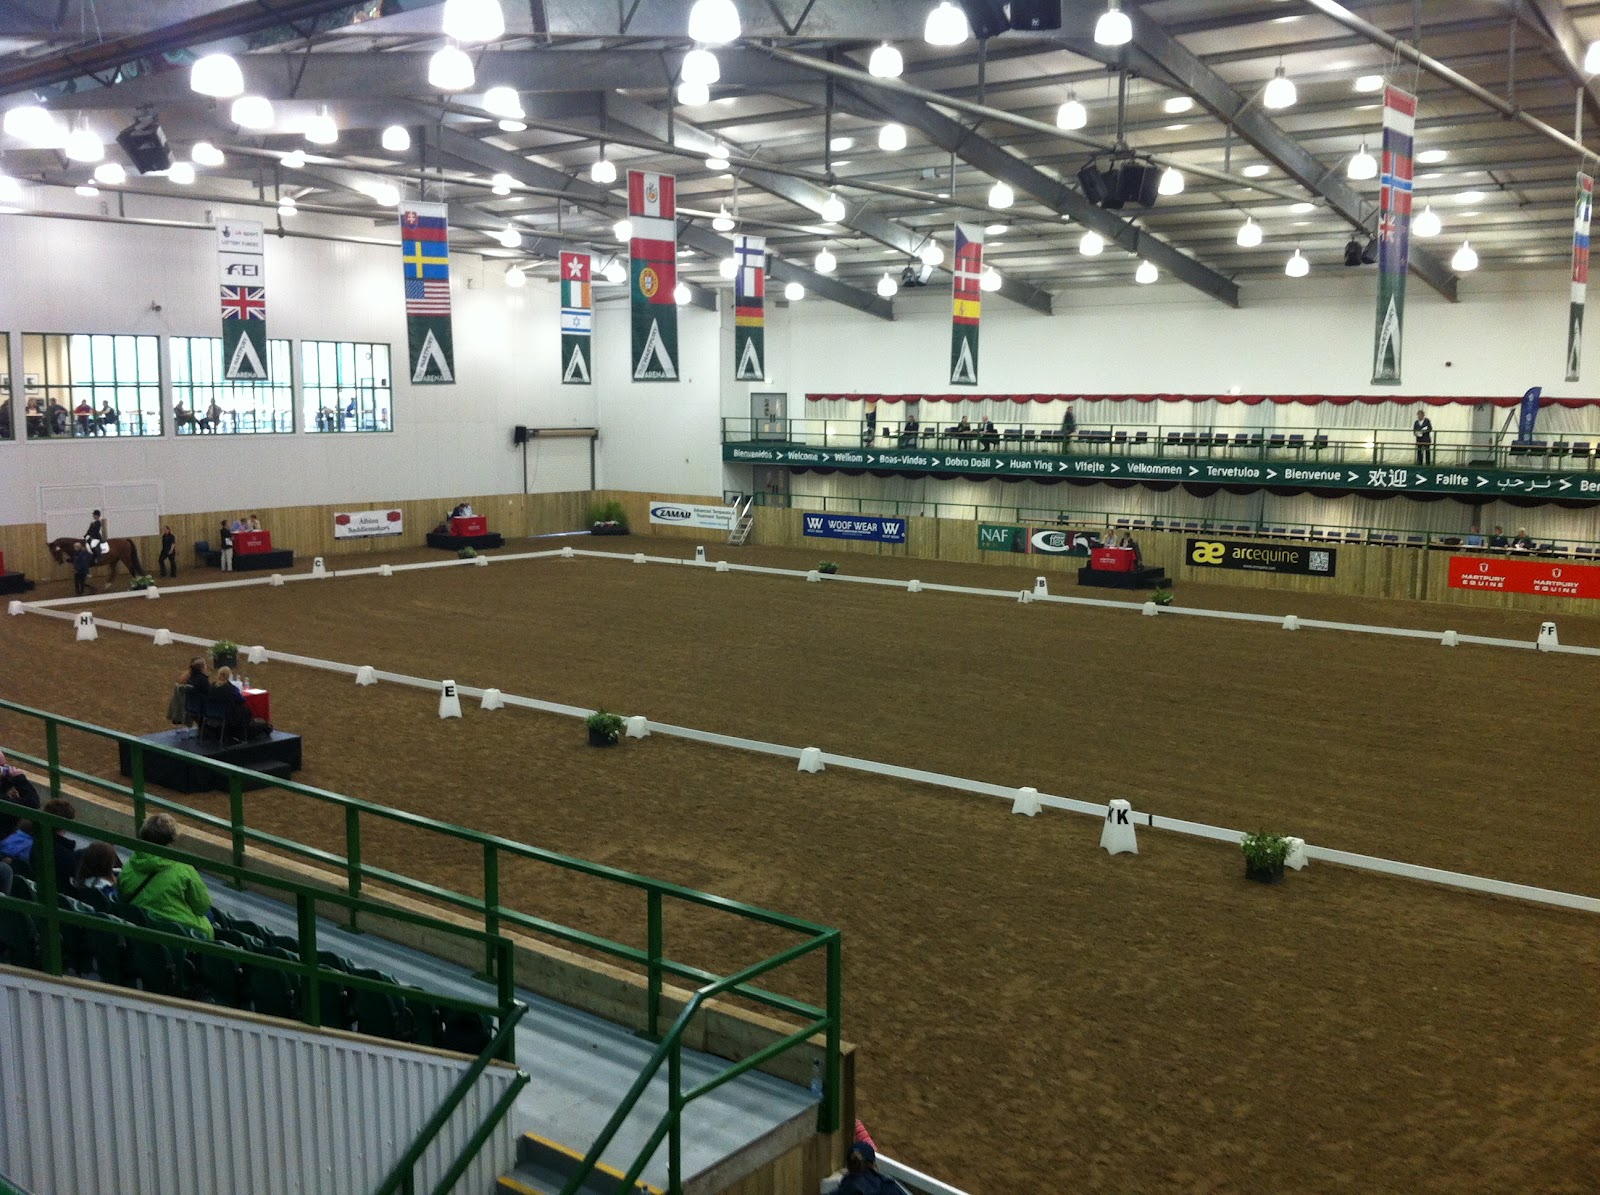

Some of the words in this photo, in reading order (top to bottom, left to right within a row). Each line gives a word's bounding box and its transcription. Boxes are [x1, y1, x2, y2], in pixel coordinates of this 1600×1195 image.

[226, 263, 259, 277] FEI
[787, 451, 819, 461] Welcome
[834, 452, 863, 463] Welkom
[879, 455, 927, 466] Boas-Vindas
[945, 457, 969, 467] Dobro
[1009, 459, 1032, 469] Huan
[1033, 460, 1053, 472] Ying
[1127, 462, 1183, 474] Velkommen
[1206, 465, 1260, 478] Tervetuloa
[1284, 468, 1341, 480] Bienvenue
[1367, 468, 1408, 488] 欢迎
[659, 509, 692, 519] ZAMAR
[828, 519, 853, 530] WOOF
[853, 521, 878, 532] WEAR
[980, 528, 1009, 543] NAF
[1231, 547, 1299, 565] arcequine
[1461, 573, 1506, 582] HARTPURY
[1039, 579, 1045, 588] B
[1462, 580, 1504, 588] EQUINE
[1533, 579, 1580, 588] HARTPURY
[1534, 585, 1578, 594] EQUINE
[80, 616, 88, 625] H
[1548, 626, 1555, 635] F
[445, 685, 455, 697] E
[1117, 808, 1129, 825] K
